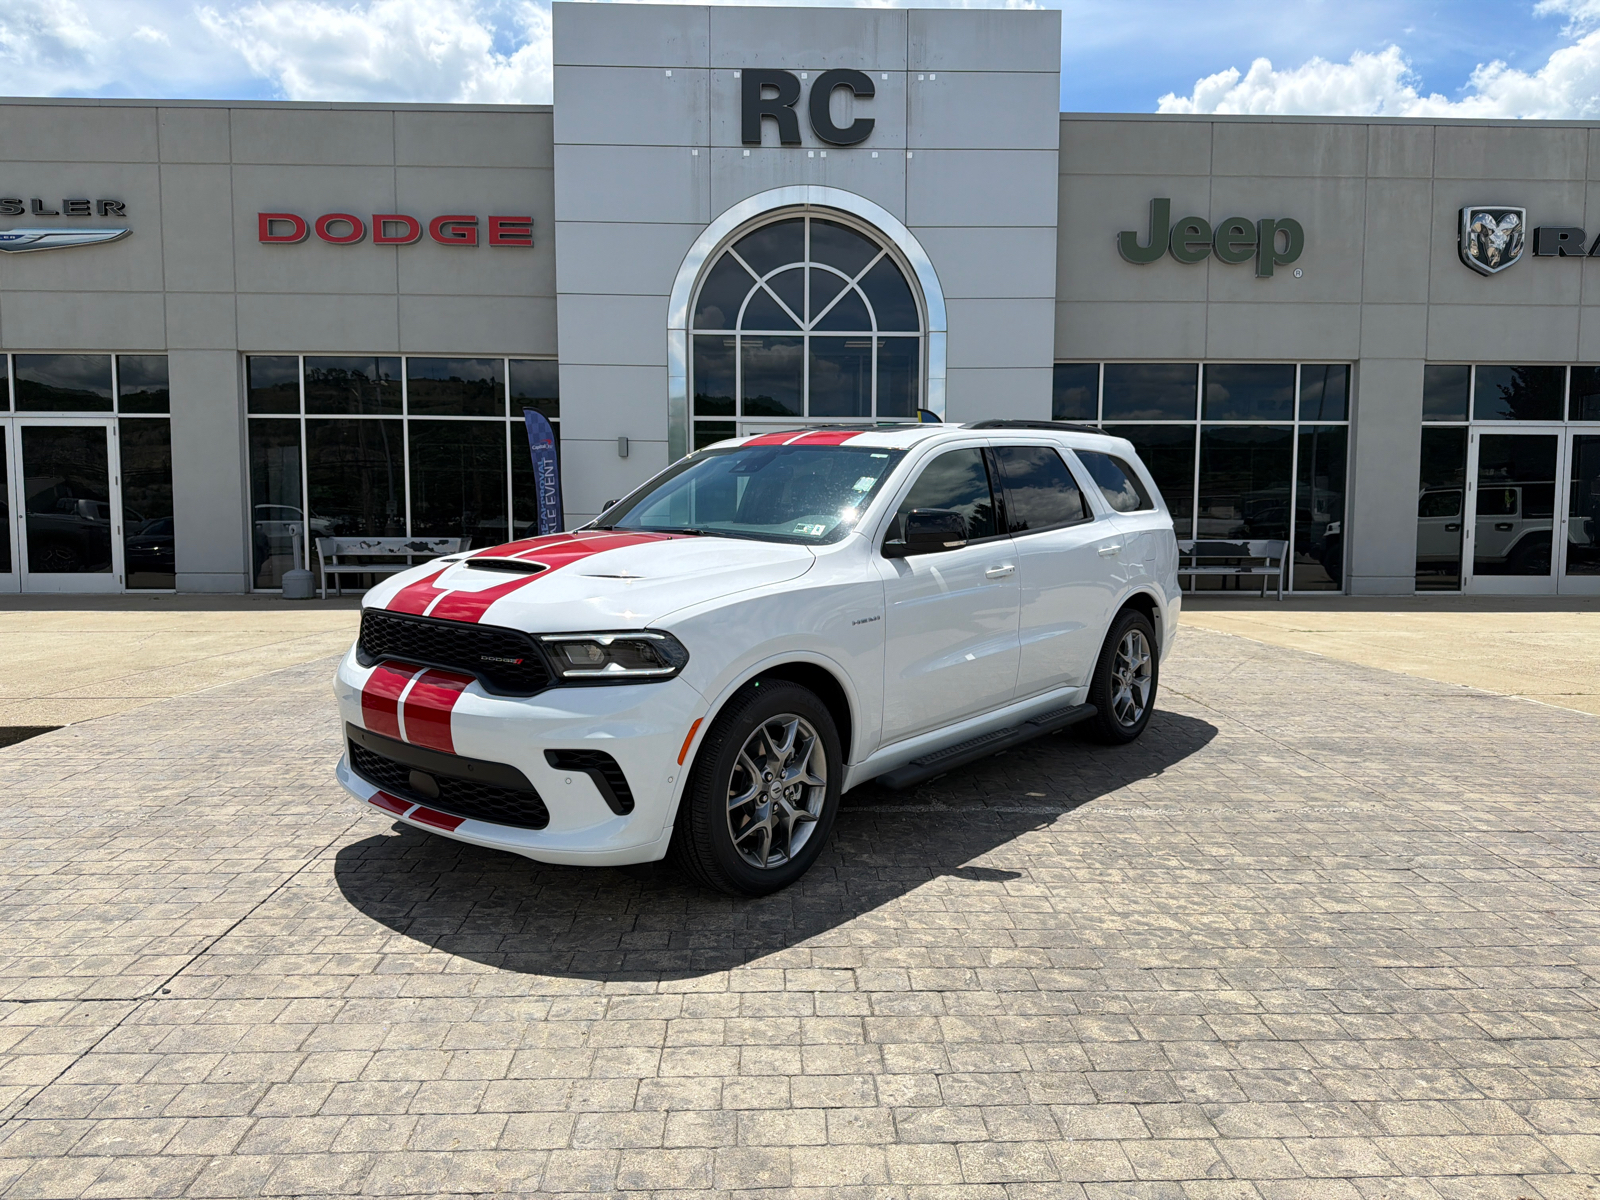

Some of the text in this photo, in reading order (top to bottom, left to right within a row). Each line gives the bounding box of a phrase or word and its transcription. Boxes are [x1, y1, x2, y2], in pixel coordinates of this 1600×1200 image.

[741, 68, 876, 146] RC
[258, 212, 534, 248] DODGE
[1117, 198, 1304, 278] Jeep
[1532, 226, 1600, 257] R
[543, 457, 556, 505] EVENT
[480, 655, 518, 663] DODGE
